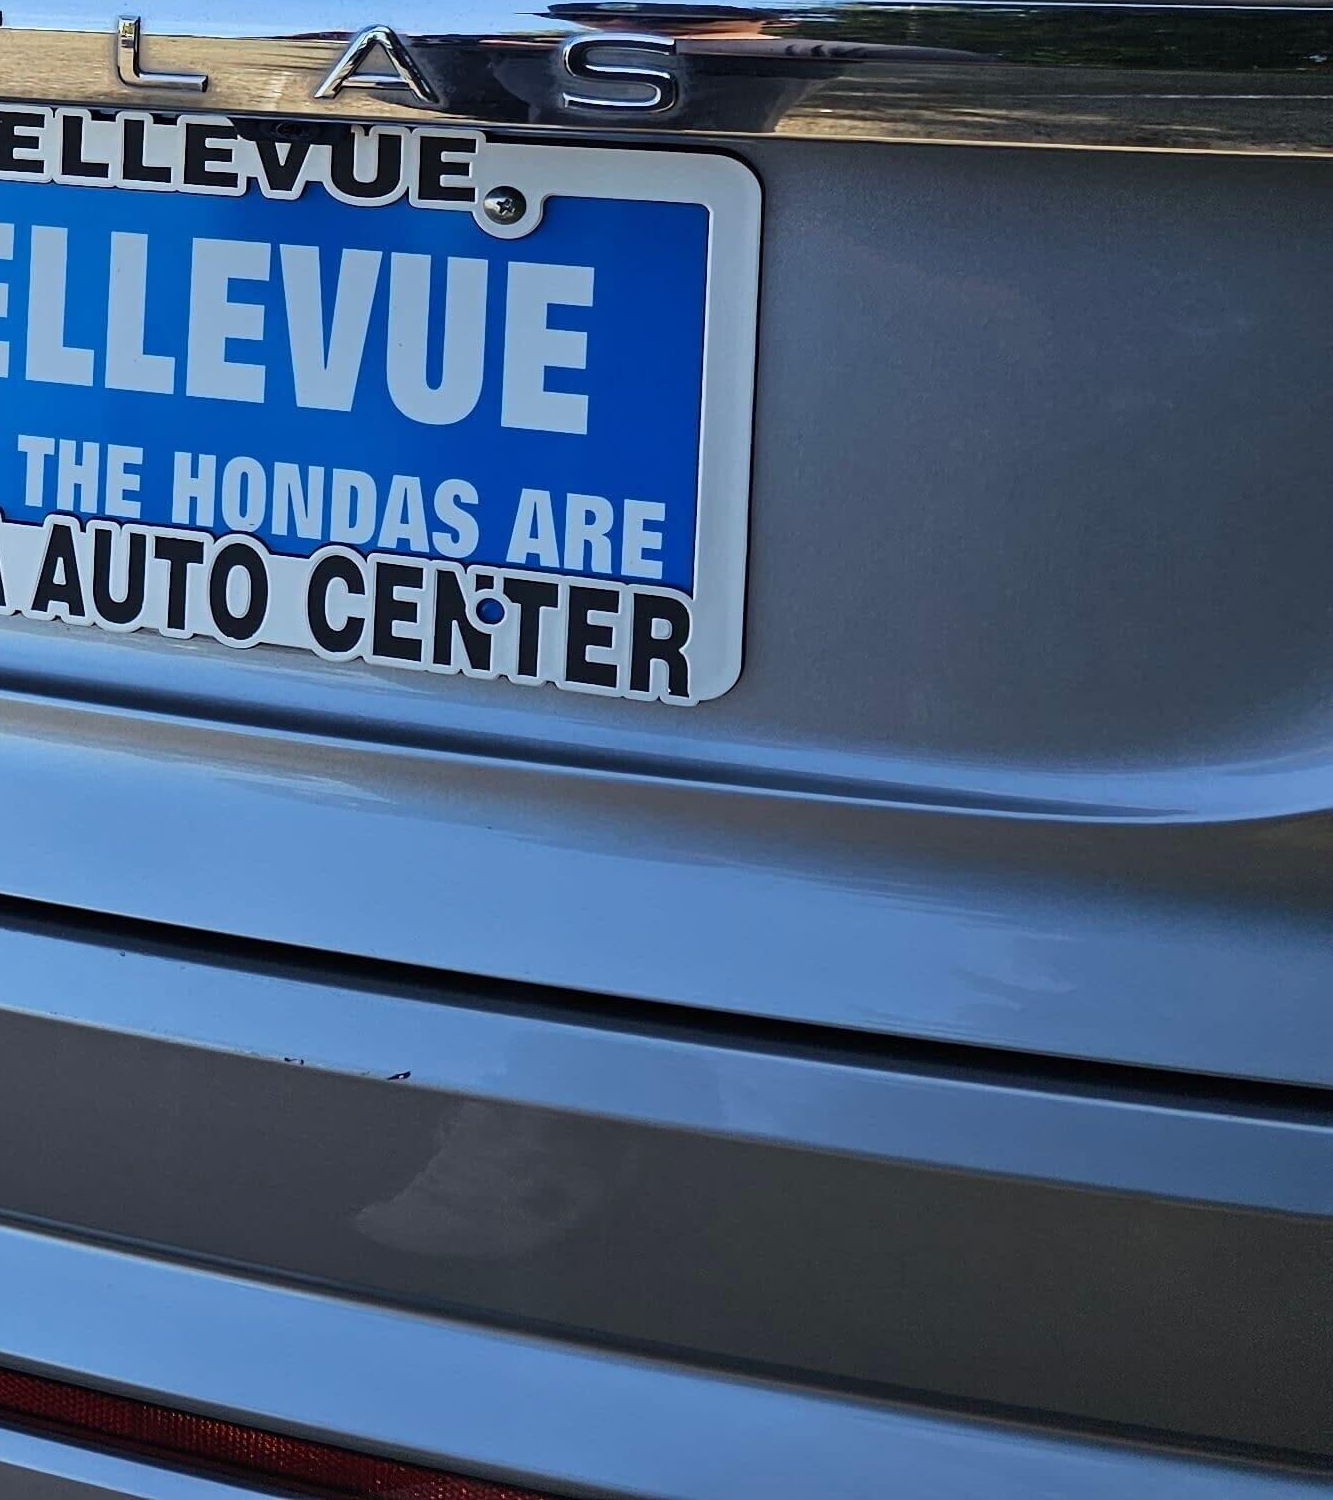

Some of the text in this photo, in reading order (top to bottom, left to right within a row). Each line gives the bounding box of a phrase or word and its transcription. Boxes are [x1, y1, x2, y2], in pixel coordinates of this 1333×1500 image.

[17, 434, 144, 519] THE
[171, 450, 480, 559] HONDAS
[505, 488, 667, 580] ARE
[31, 523, 269, 641] AUTO
[307, 553, 693, 699] CENTER
